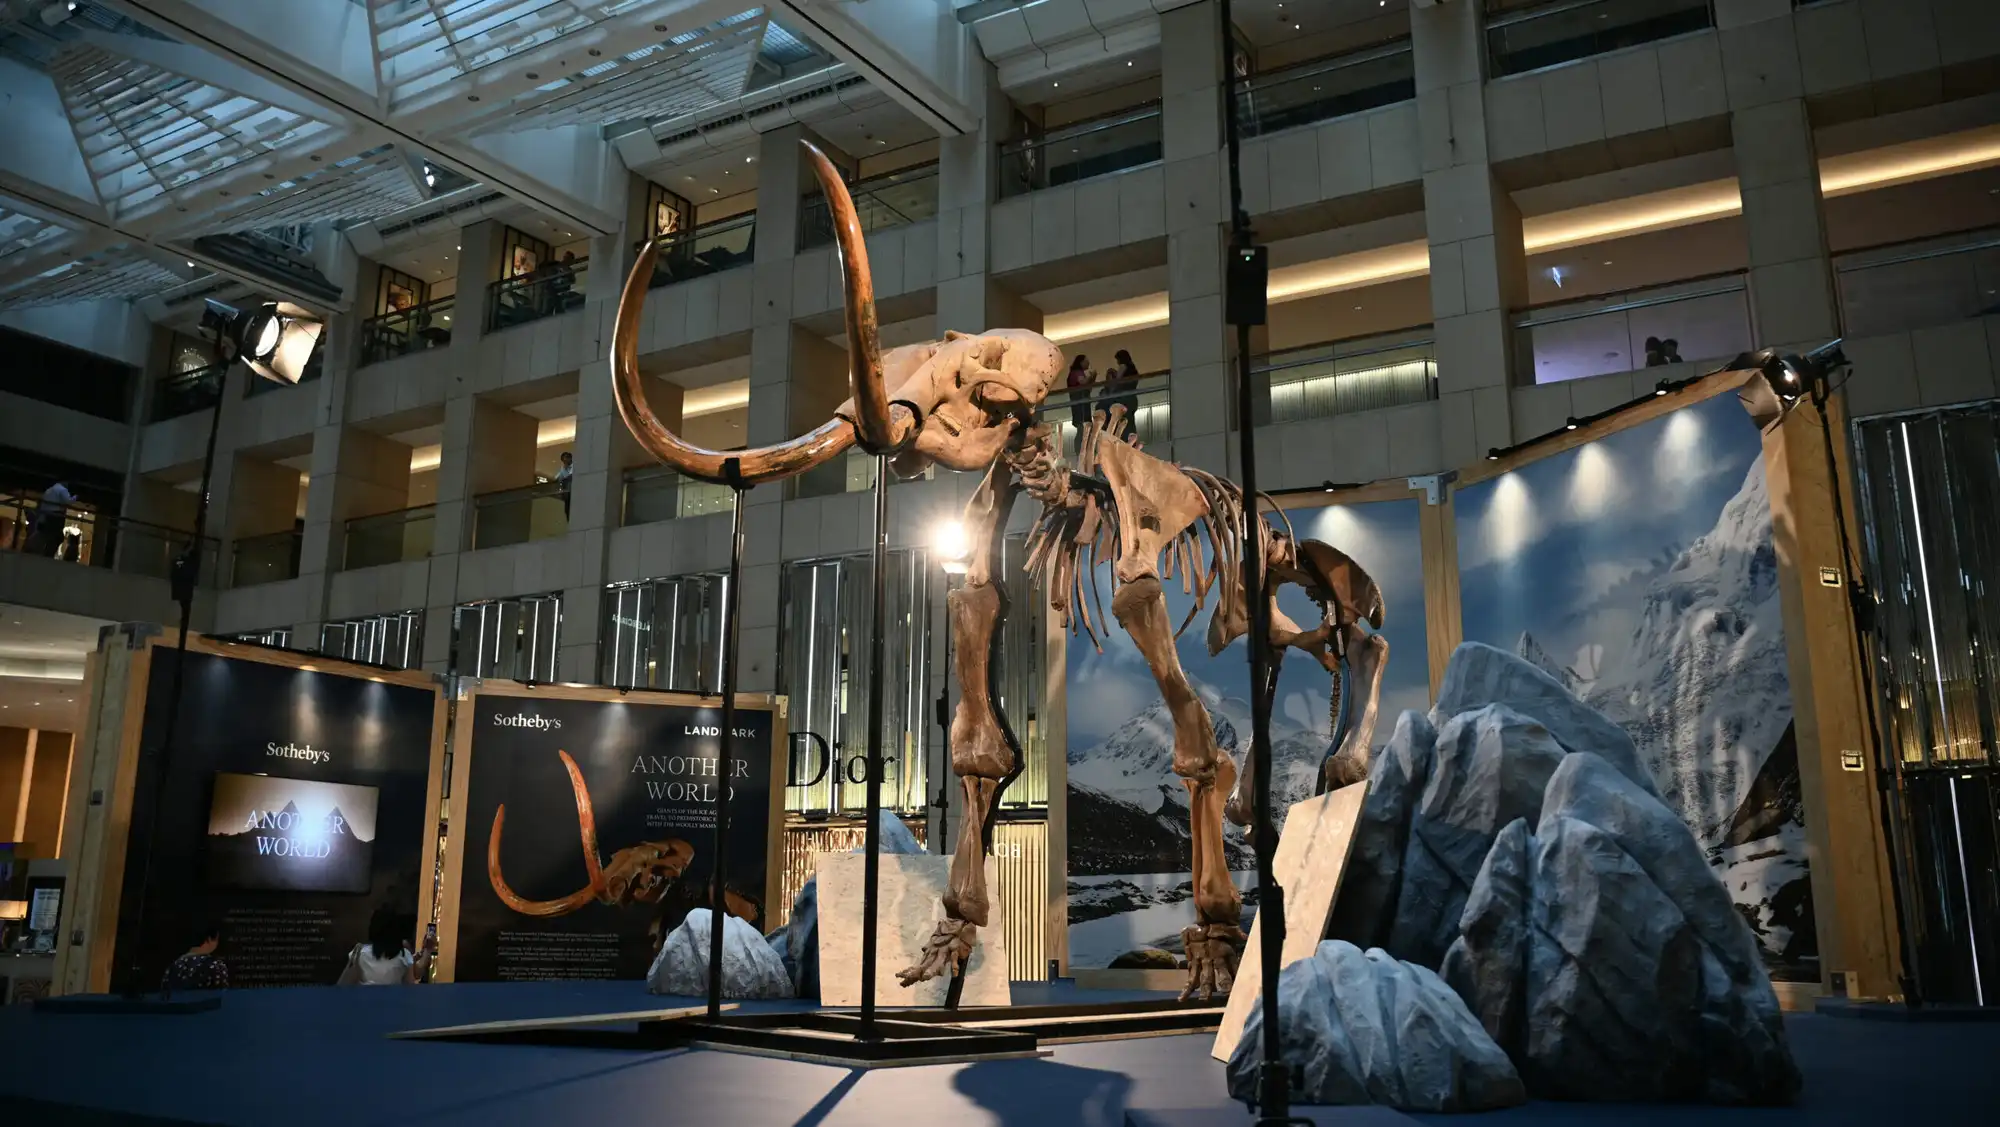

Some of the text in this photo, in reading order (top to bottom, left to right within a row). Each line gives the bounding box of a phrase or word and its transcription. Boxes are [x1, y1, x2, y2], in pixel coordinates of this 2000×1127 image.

[493, 713, 562, 731] Sotheby's
[684, 725, 756, 738] LANDARK
[266, 742, 331, 764] Sotheby's
[786, 731, 895, 787] Dior
[631, 755, 750, 778] ANOTHR
[244, 809, 344, 834] ANOTER
[256, 836, 331, 858] WORLD
